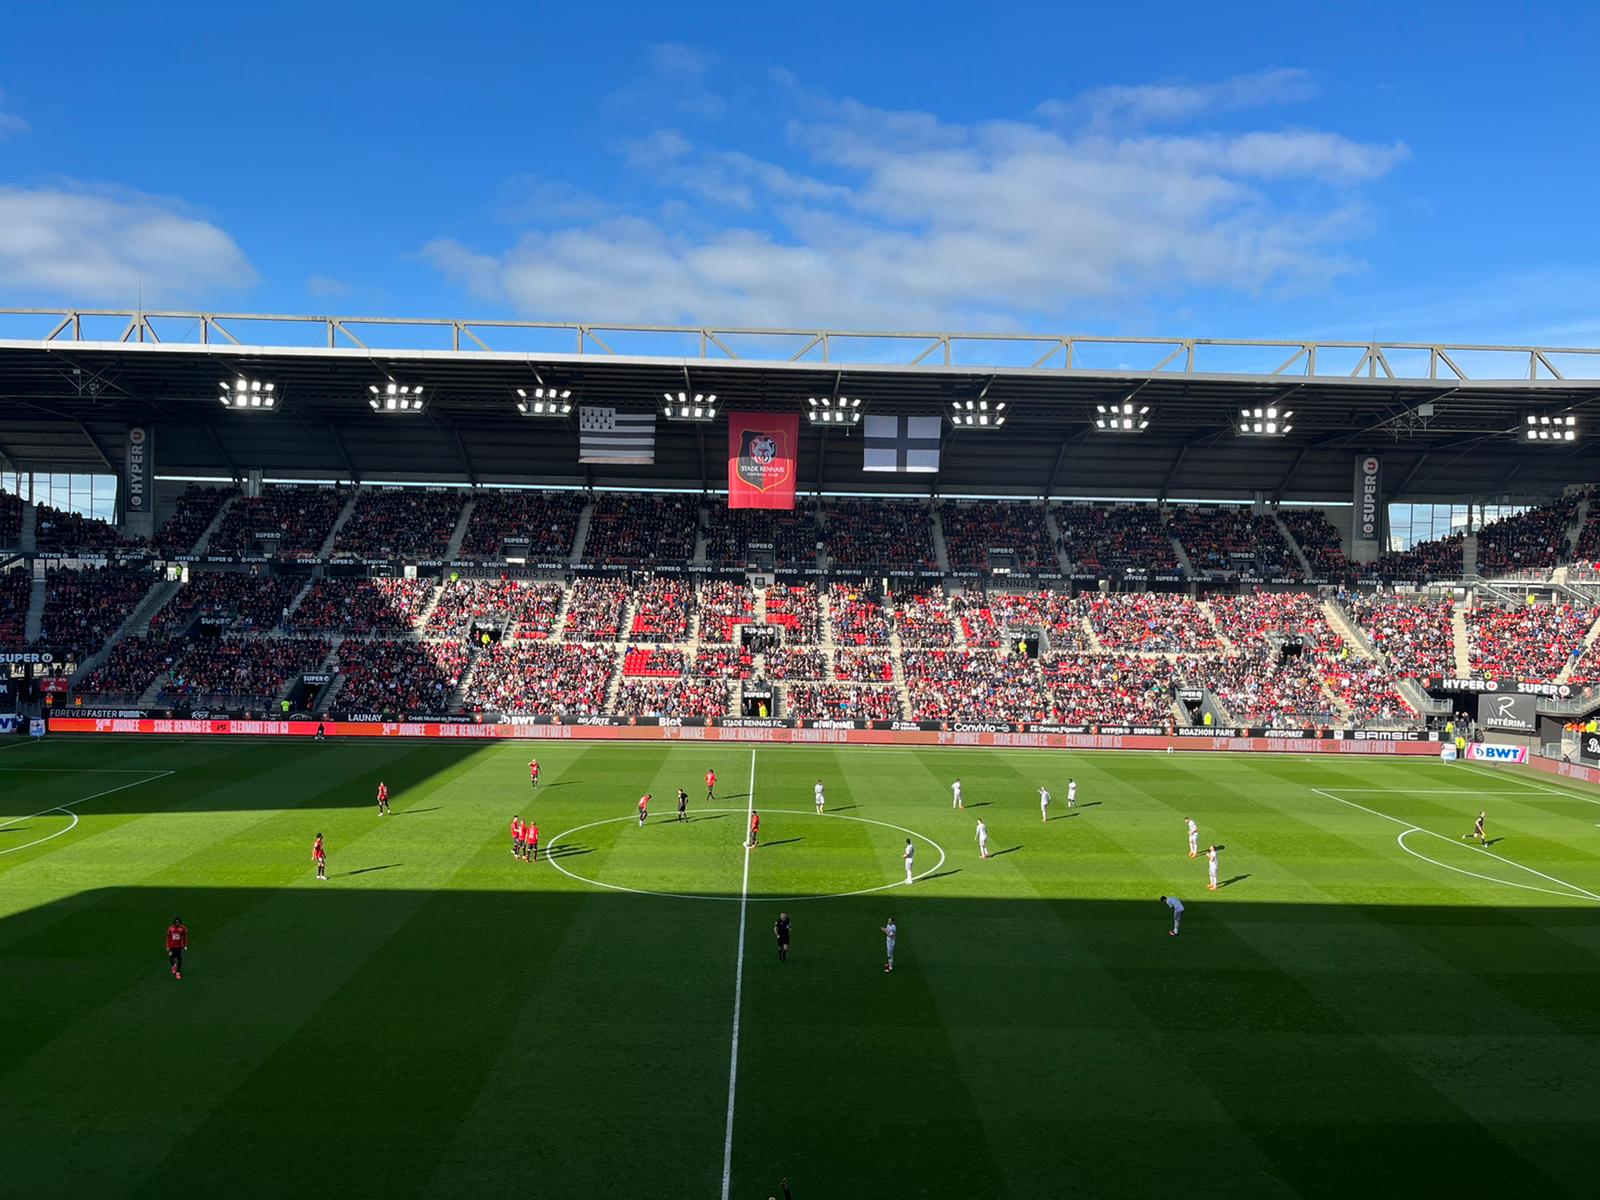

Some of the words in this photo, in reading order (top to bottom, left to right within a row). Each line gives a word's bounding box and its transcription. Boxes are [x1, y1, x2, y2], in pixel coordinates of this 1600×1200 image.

[131, 444, 143, 494] HYPER
[1363, 474, 1377, 523] SUPER
[495, 570, 540, 578] RNNAIS
[992, 579, 1036, 588] RENNAIS
[0, 653, 40, 663] SUPER
[1443, 679, 1485, 691] HYPER
[1518, 683, 1558, 695] SUPER
[1497, 696, 1516, 719] R
[348, 713, 383, 722] LAUNAY
[512, 716, 535, 724] BWT
[1487, 717, 1526, 727] INTÉRIM
[154, 720, 173, 733] STADE
[231, 721, 262, 734] CLERMONT
[265, 721, 279, 734] FOOT
[722, 719, 742, 727] STADE
[954, 723, 996, 732] Convivio
[1133, 727, 1155, 735] SUPER
[1179, 728, 1214, 736] ROAZHON
[1215, 728, 1236, 737] PARK
[1354, 732, 1418, 740] SAMSIC
[1486, 747, 1519, 759] BWT
